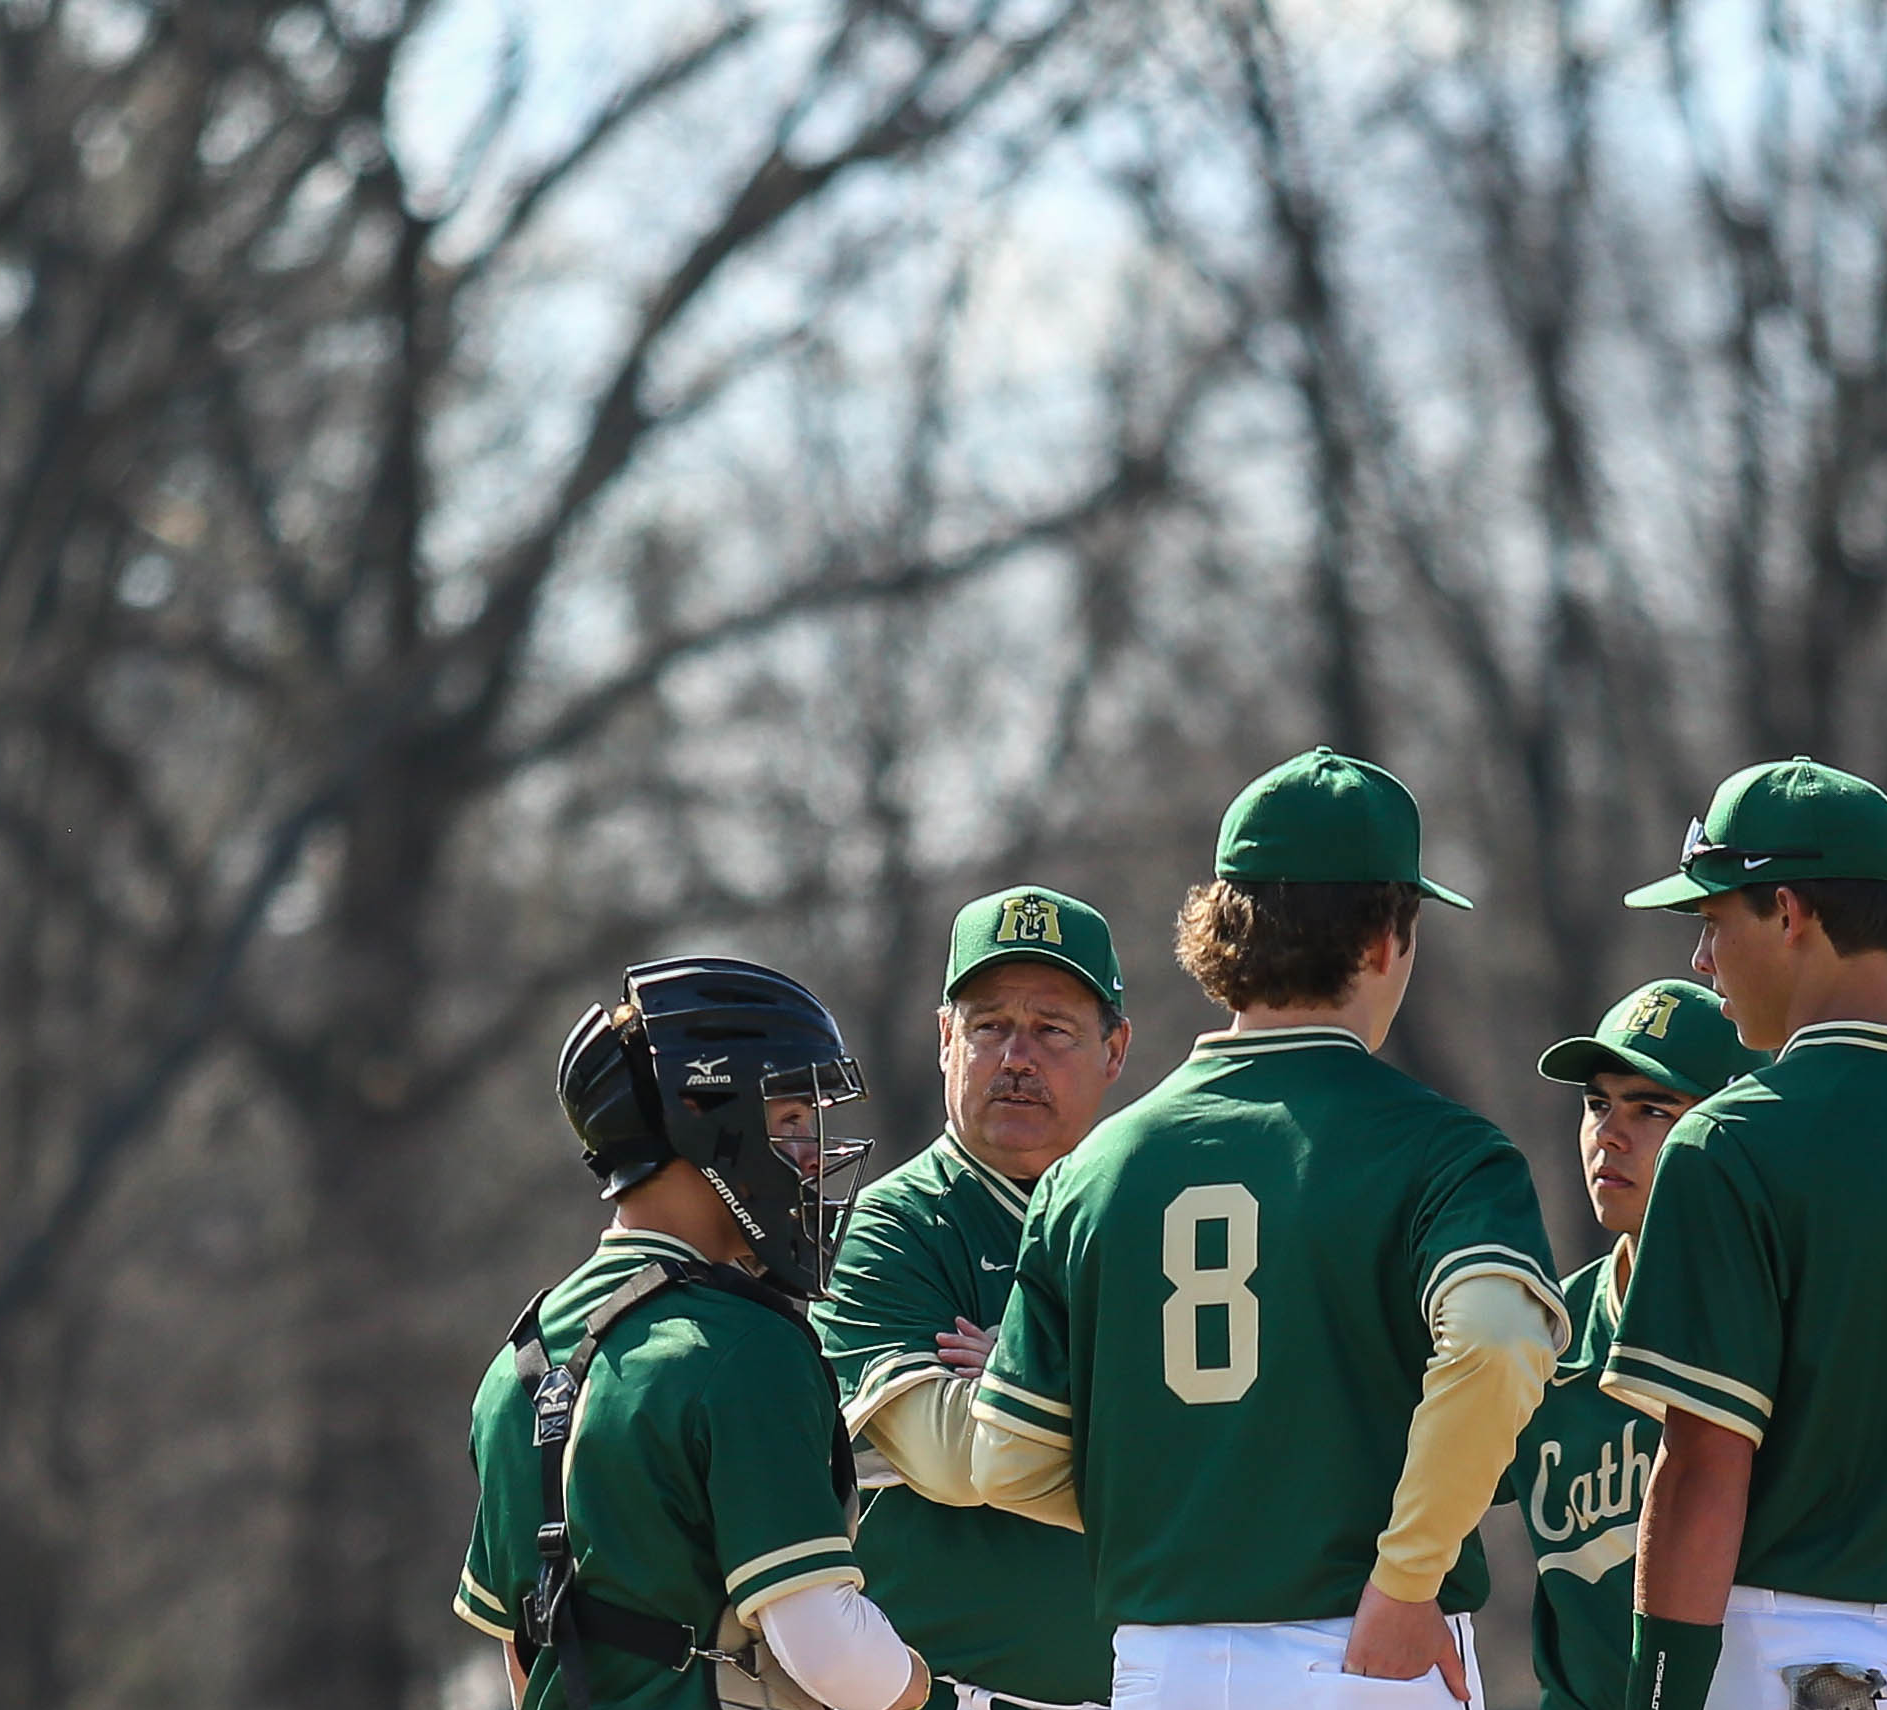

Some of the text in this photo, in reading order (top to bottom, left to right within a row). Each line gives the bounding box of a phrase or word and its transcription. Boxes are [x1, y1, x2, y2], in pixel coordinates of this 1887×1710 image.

[700, 1166, 766, 1241] SAMURAI
[1162, 1182, 1261, 1405] 8
[1530, 1418, 1651, 1542] Cath
